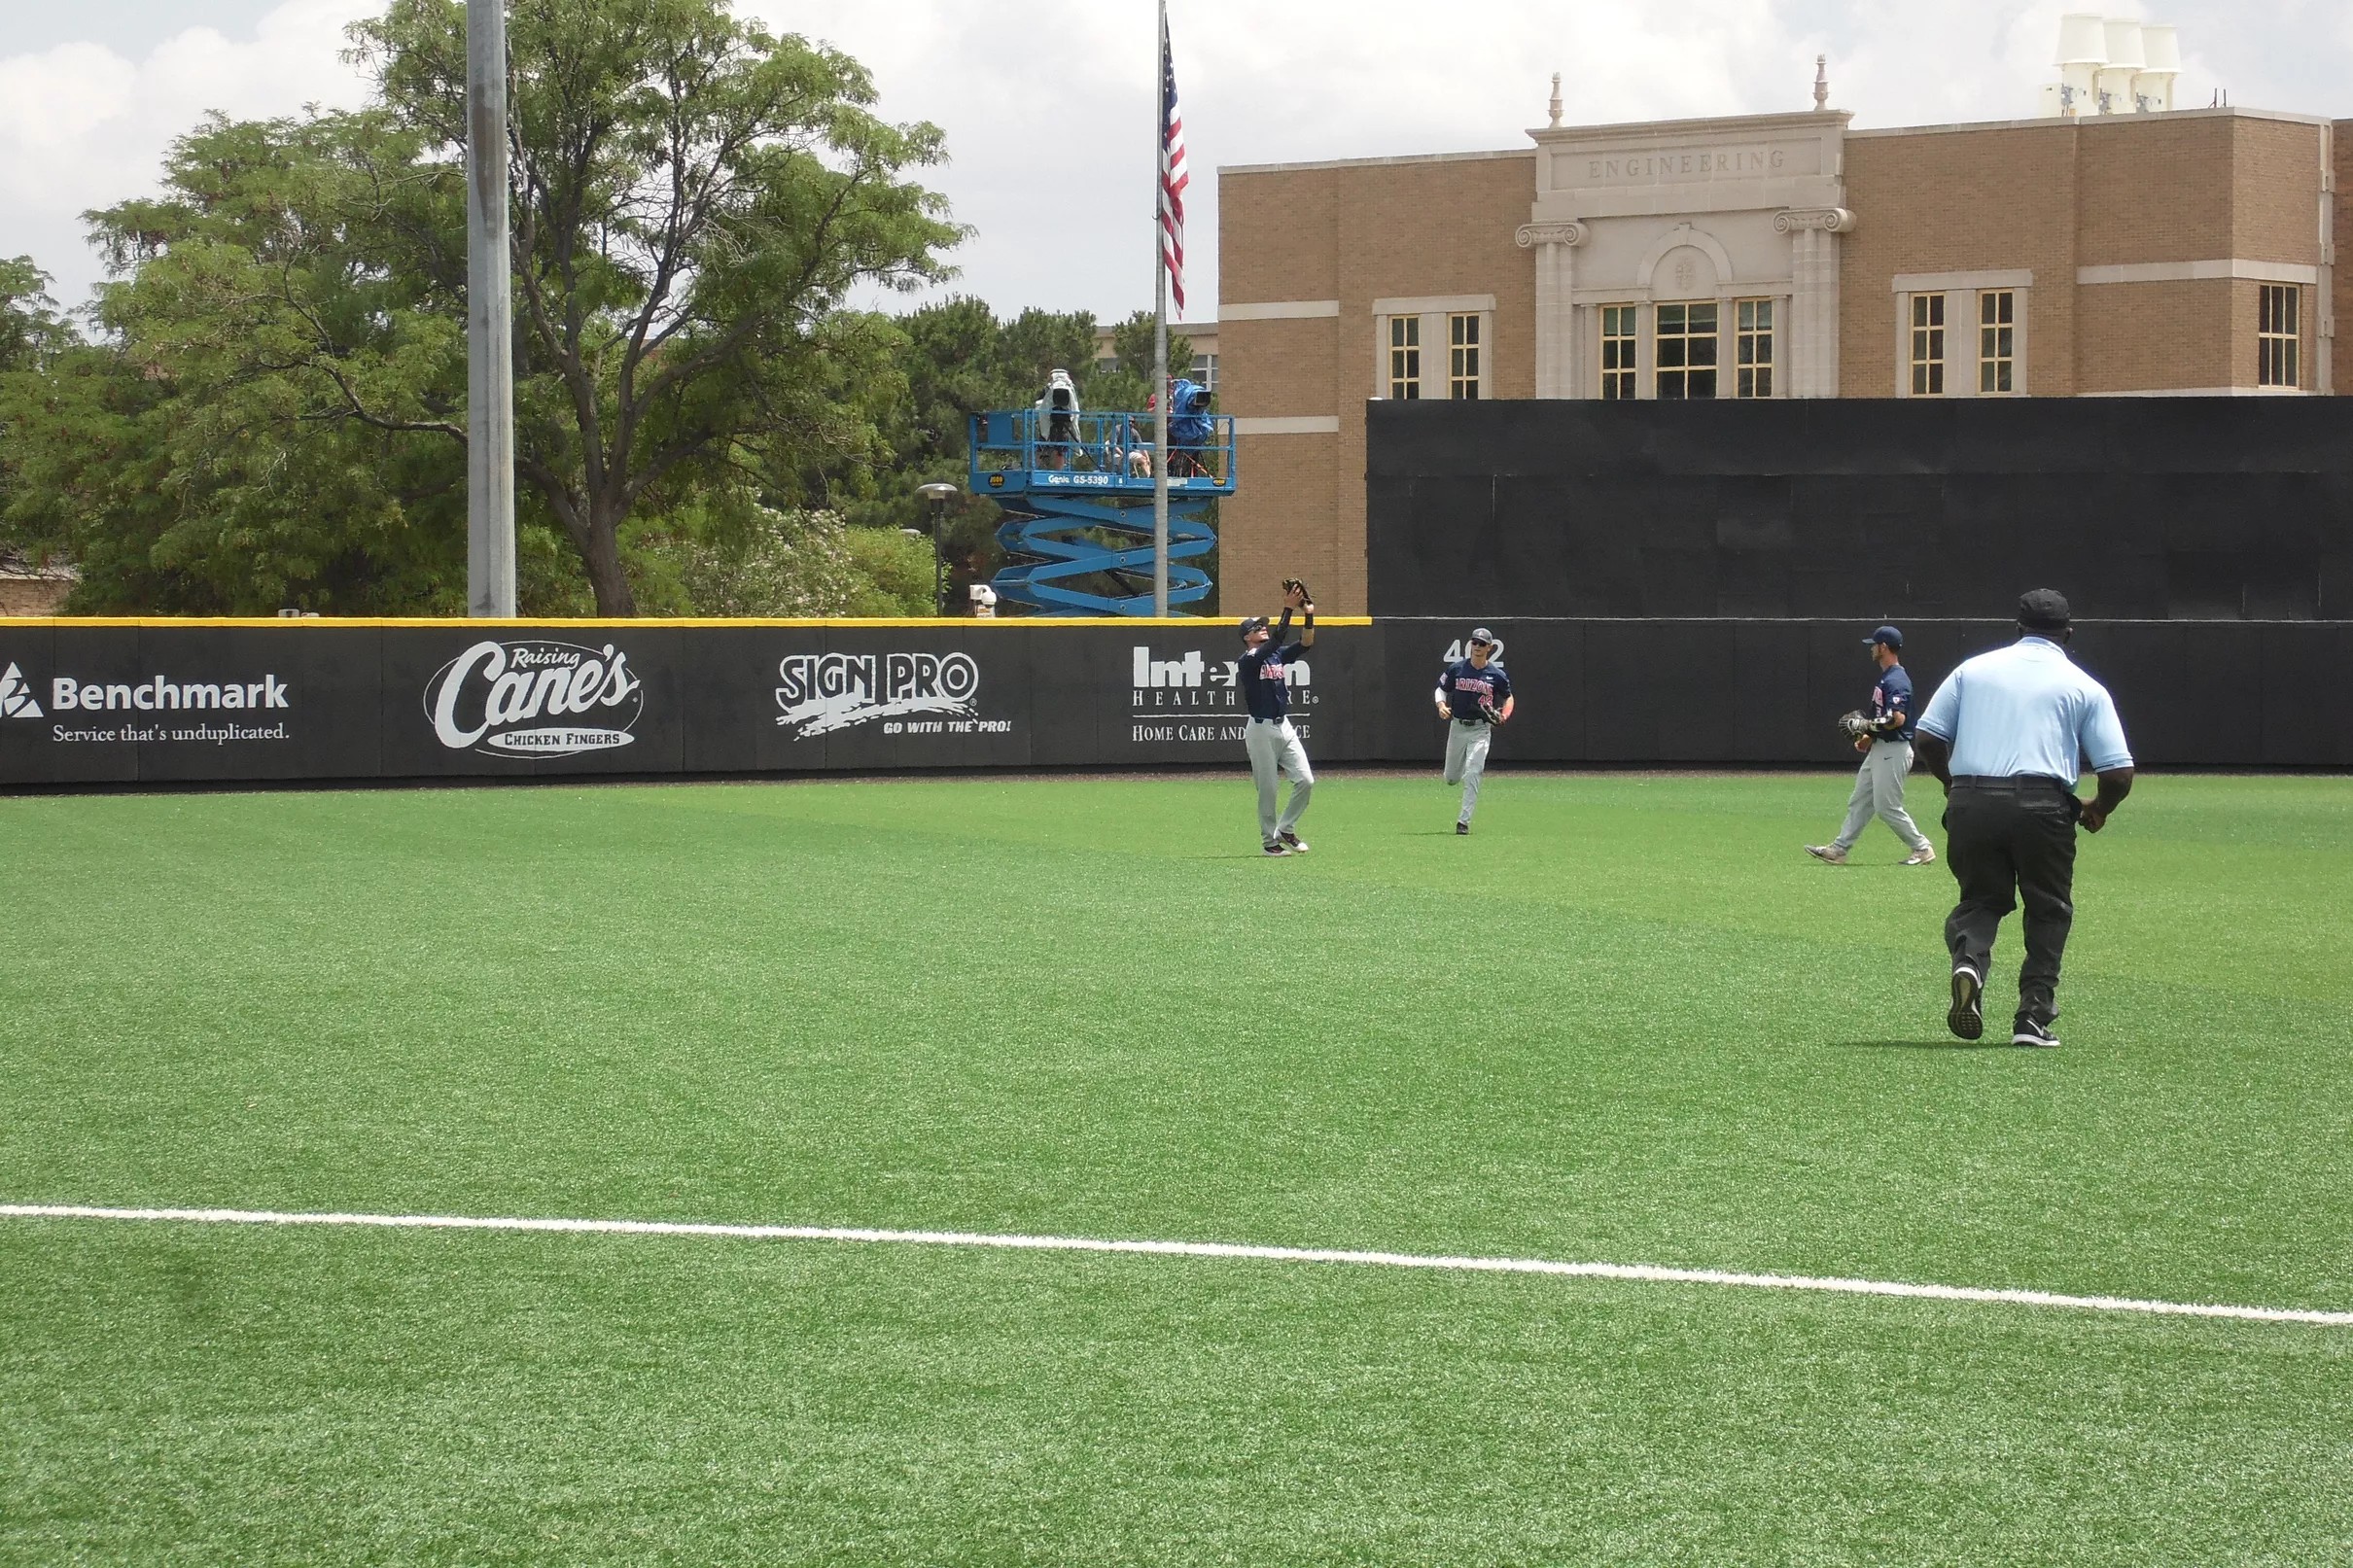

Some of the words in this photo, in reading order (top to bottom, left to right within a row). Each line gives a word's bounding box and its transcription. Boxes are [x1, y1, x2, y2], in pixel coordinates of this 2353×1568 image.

[1588, 150, 1785, 179] ENGINEERING
[1072, 475, 1108, 485] GS-5390
[510, 647, 581, 670] Raising
[1133, 645, 1311, 687] Interm
[53, 674, 290, 711] Benchmark
[775, 653, 877, 714] SIGN
[886, 651, 980, 702] PRO
[435, 641, 642, 749] Cane's
[1132, 689, 1311, 707] HEALTHRE
[53, 724, 117, 742] Service
[121, 723, 167, 742] that's
[172, 722, 291, 746] unduplicated.
[883, 721, 902, 735] GO
[907, 720, 943, 734] WITH
[948, 720, 972, 733] THE
[977, 719, 1012, 733] PRO!
[1132, 724, 1175, 742] HOME
[1178, 723, 1215, 742] CARE
[1219, 725, 1247, 741] AND
[504, 733, 561, 747] CHICKEN
[565, 732, 620, 746] FINGERS
